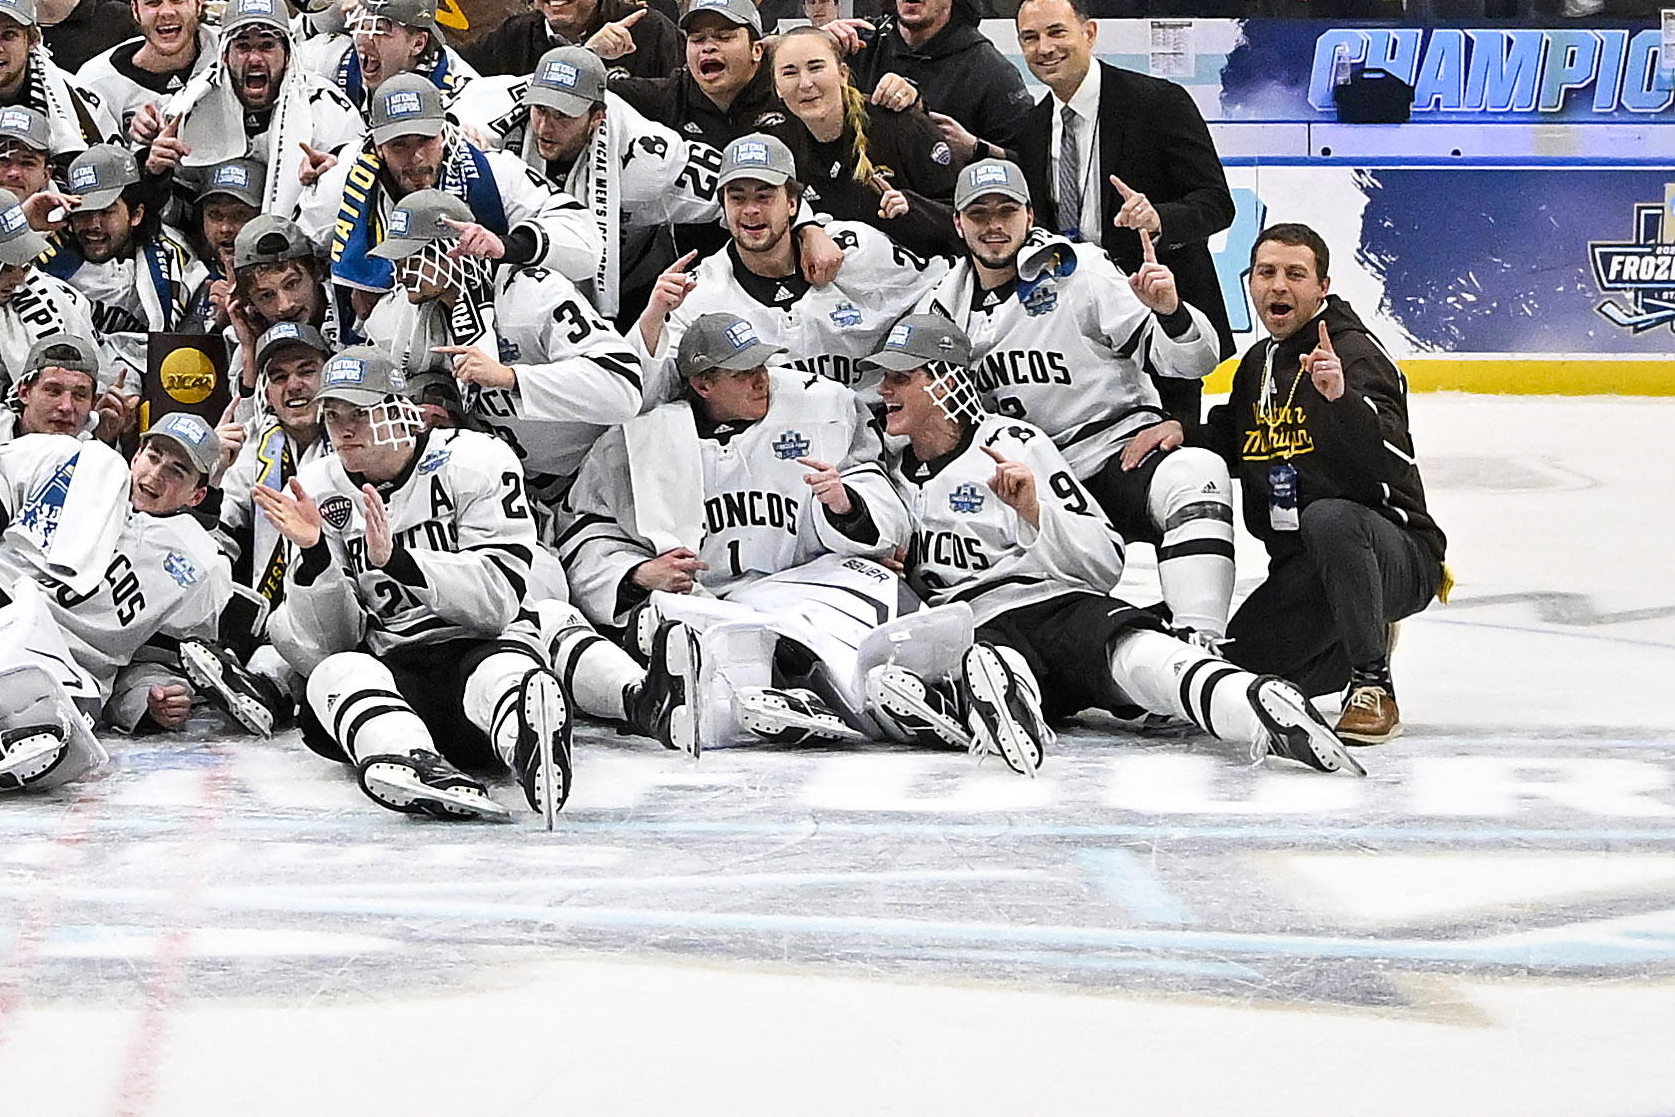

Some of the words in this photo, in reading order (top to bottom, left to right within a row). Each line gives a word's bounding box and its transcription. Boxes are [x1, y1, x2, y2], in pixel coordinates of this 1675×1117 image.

[674, 143, 724, 203] 26
[1608, 255, 1675, 281] FROZ
[167, 372, 216, 391] NCAA
[320, 498, 353, 518] NCHC
[430, 475, 454, 519] A
[705, 490, 801, 538] ONCOS
[726, 539, 743, 578] 1
[842, 559, 891, 584] BAUER
